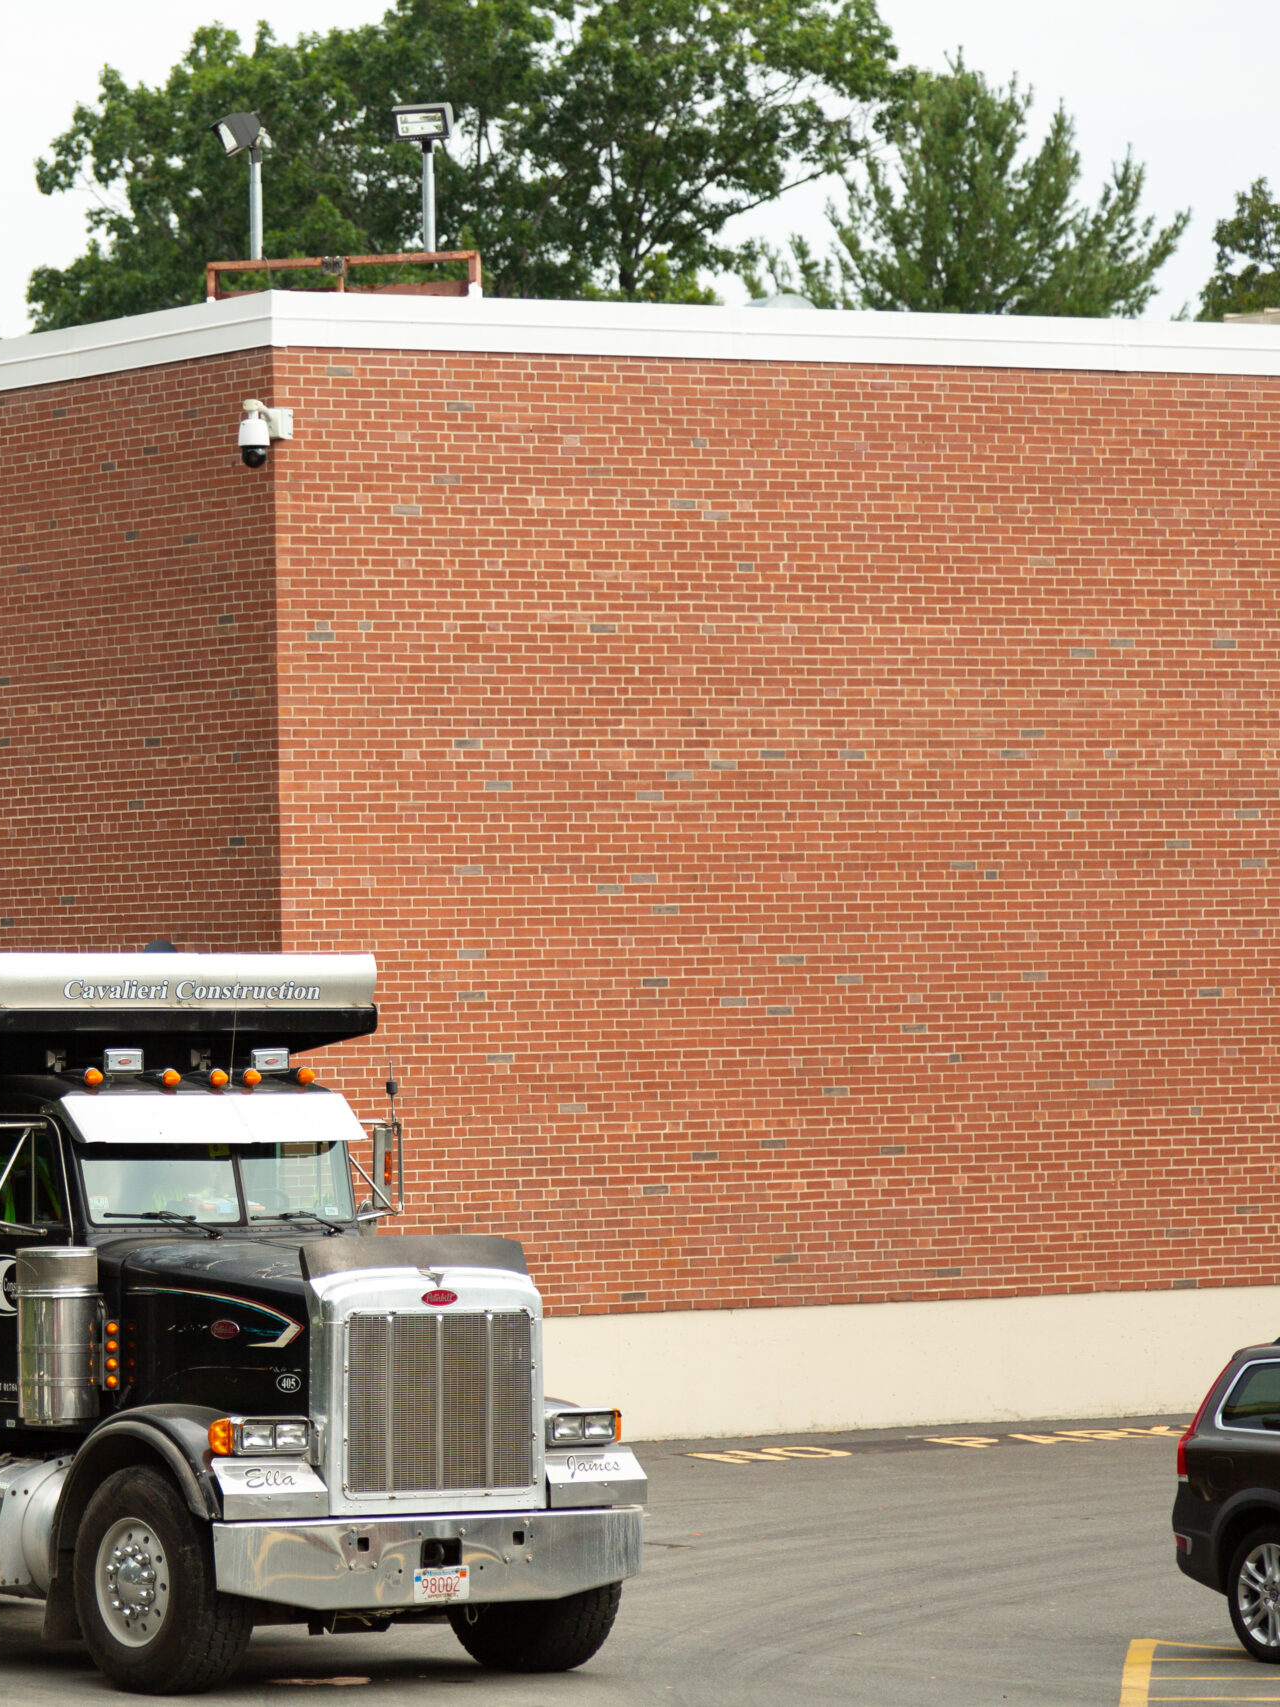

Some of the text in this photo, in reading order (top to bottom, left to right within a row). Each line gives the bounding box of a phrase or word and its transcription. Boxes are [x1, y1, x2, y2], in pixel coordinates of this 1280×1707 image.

[63, 978, 321, 1000] Cavalieri Construction
[281, 1378, 296, 1389] 405
[683, 1424, 1192, 1464] NO PARK
[566, 1455, 621, 1479] James
[245, 1468, 297, 1488] Ella
[421, 1575, 460, 1595] 98002
